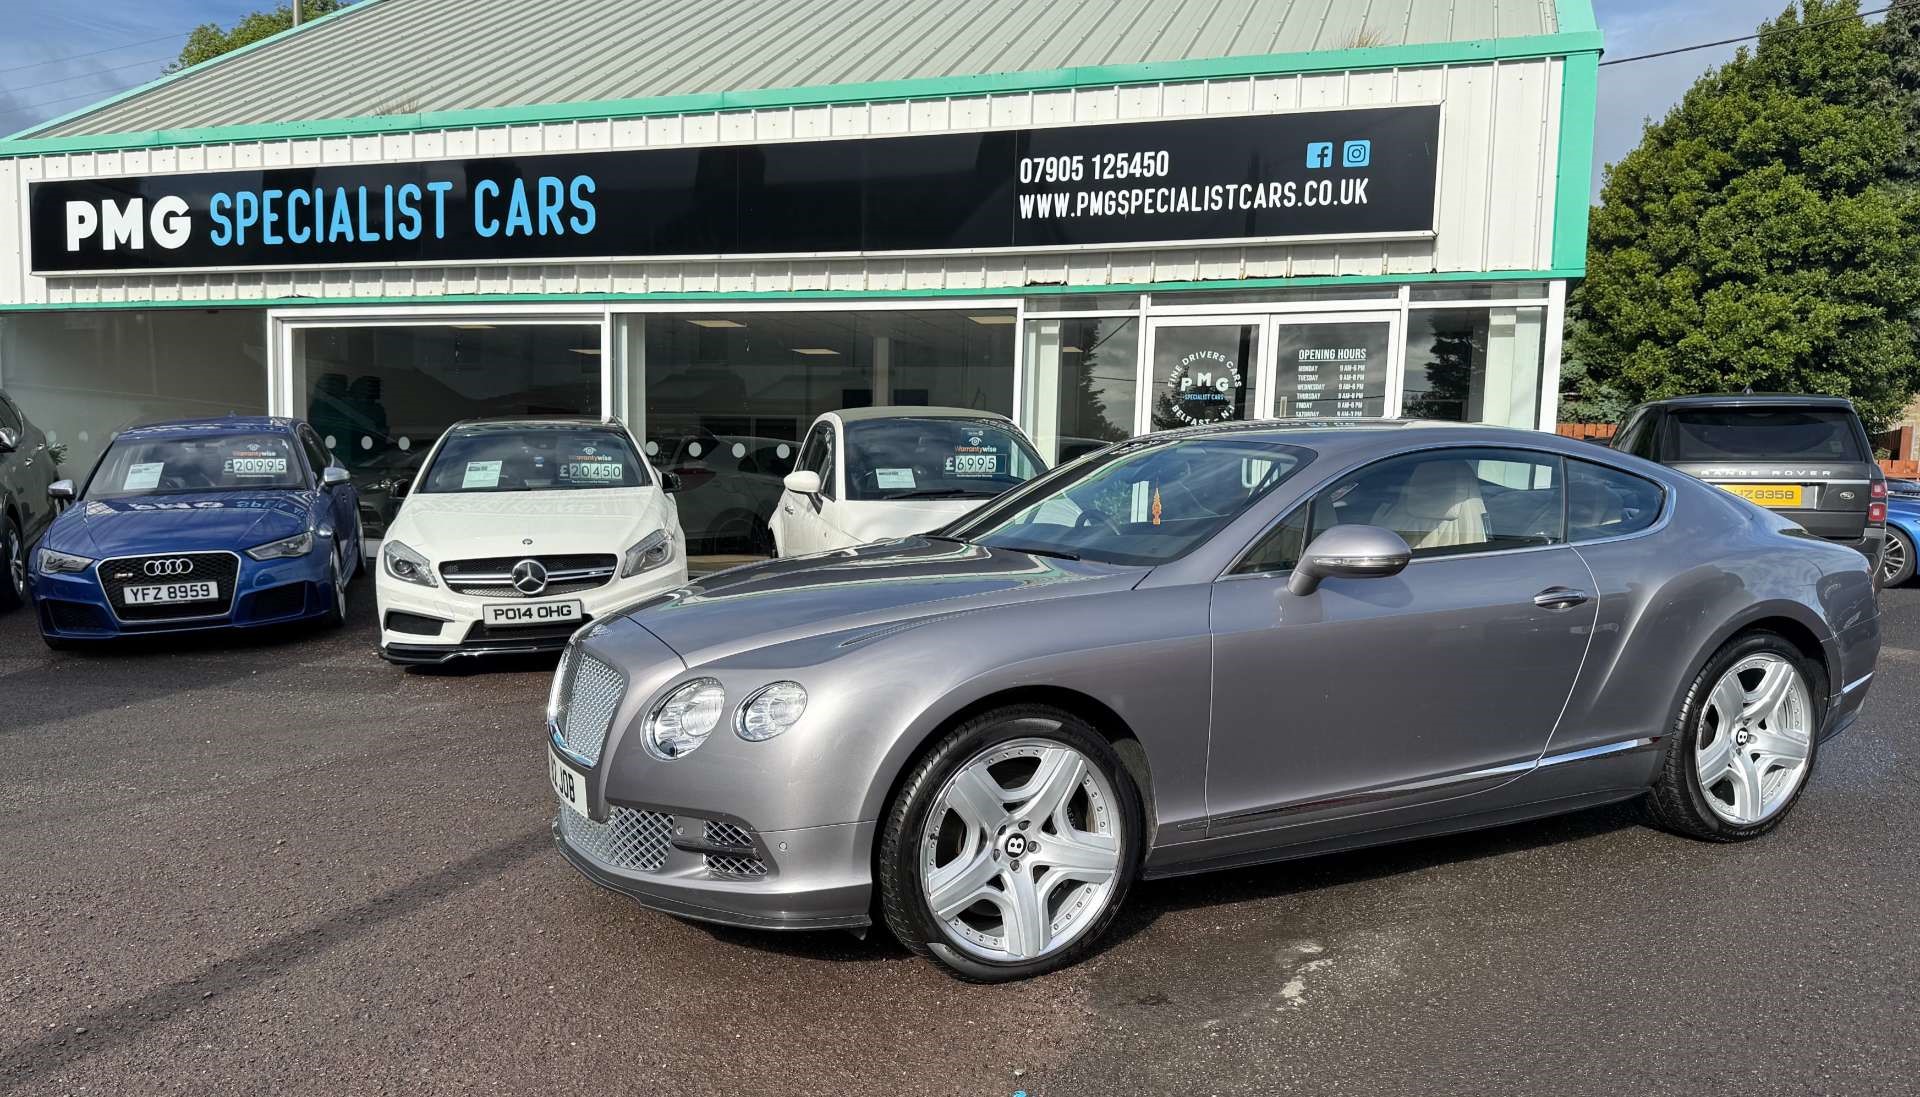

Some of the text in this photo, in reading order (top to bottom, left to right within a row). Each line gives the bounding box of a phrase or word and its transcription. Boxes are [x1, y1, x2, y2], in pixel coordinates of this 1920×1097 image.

[1020, 150, 1169, 184] 07905 125450
[1019, 178, 1369, 219] WWW.PMGSPECIALISTCARS.CO.UK
[66, 174, 596, 252] PMG SPECIALIST CARS
[1298, 348, 1367, 360] OPENING HOURS
[1167, 350, 1242, 388] FINE DRIVERS CARS
[1181, 372, 1229, 392] PMG
[1171, 404, 1211, 426] BELFAST
[224, 459, 285, 473] £20995
[560, 463, 621, 478] £20450
[945, 456, 996, 472] £6995
[130, 583, 210, 602] YFZ 8959
[537, 605, 572, 618] OHG
[559, 766, 575, 803] JOB
